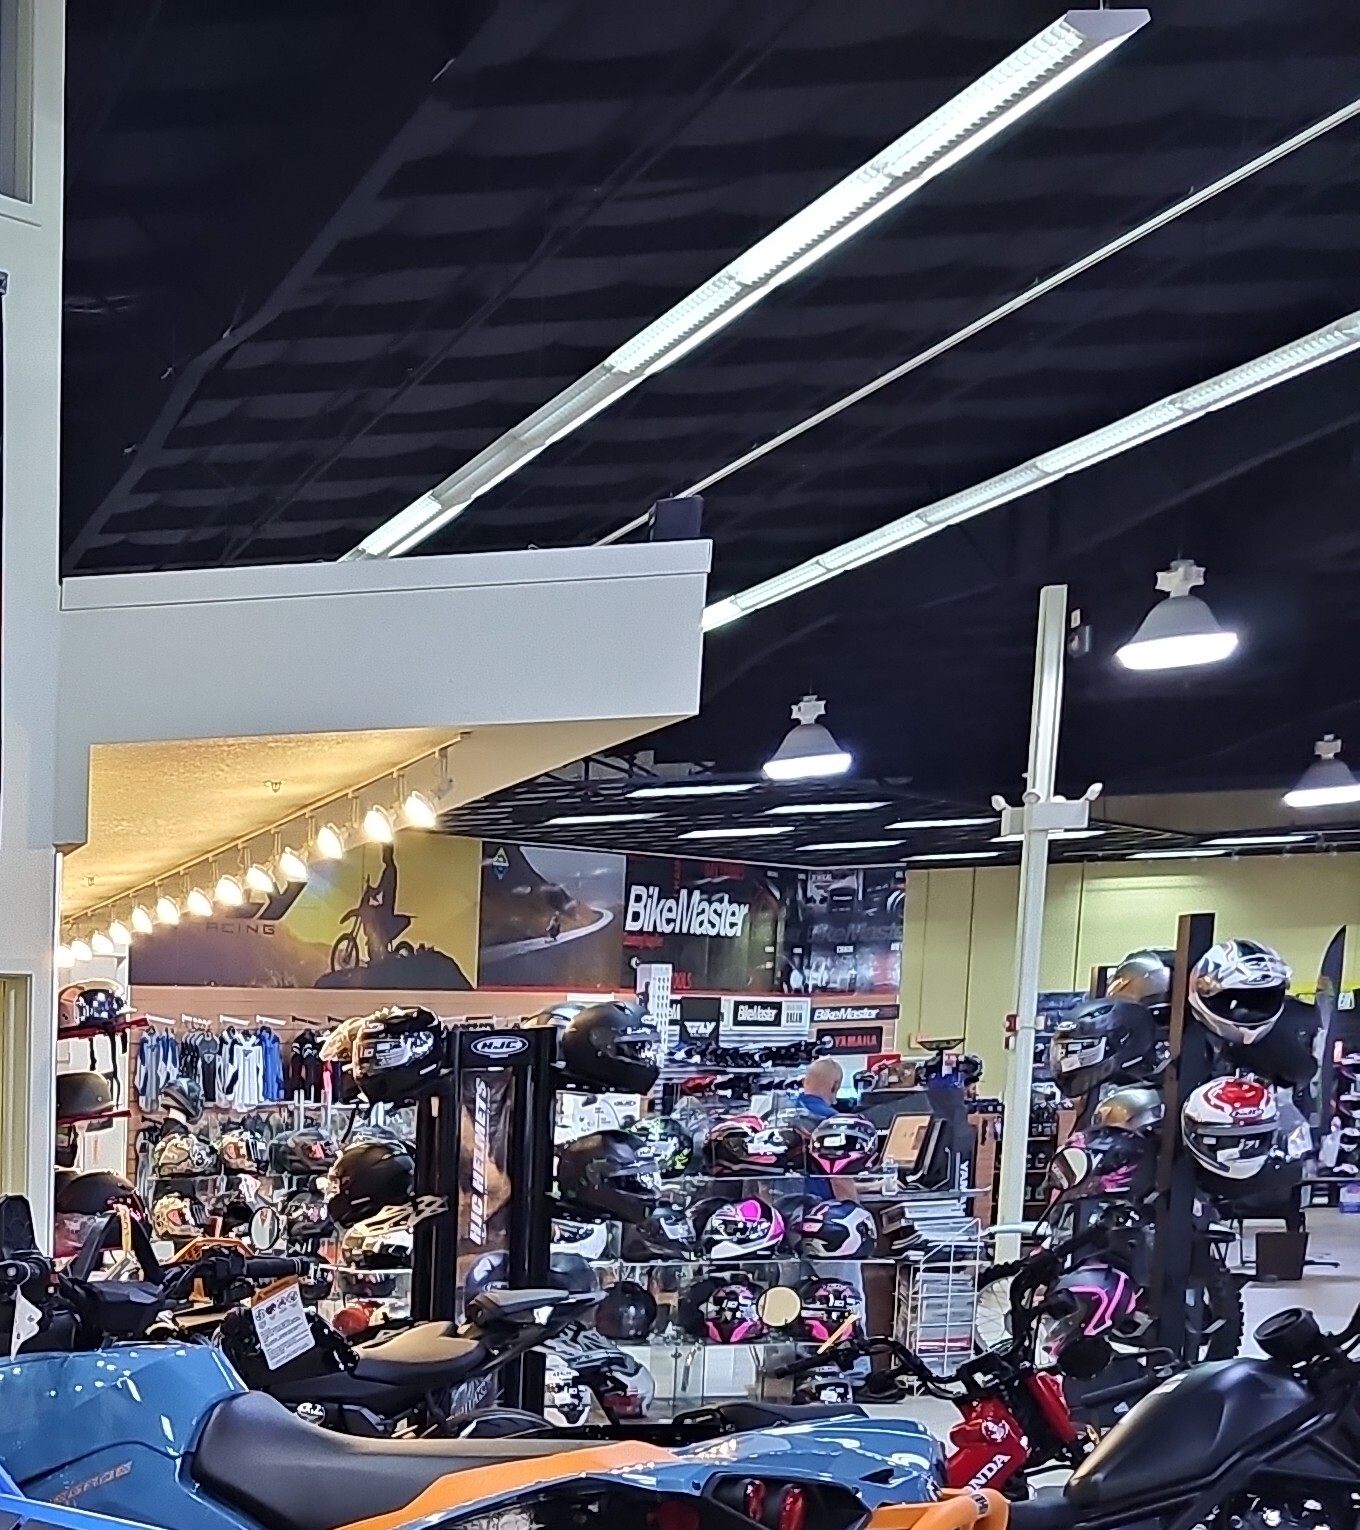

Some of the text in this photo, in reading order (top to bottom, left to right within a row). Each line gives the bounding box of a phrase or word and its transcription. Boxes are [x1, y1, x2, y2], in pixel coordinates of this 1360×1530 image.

[624, 884, 750, 937] BikeMaster
[206, 922, 276, 936] ACING
[737, 1004, 779, 1021] BikeMaster
[813, 1007, 880, 1021] BikeMaster
[481, 1040, 518, 1050] HJC
[834, 1034, 878, 1048] YAMAHA
[469, 1076, 488, 1246] HJC HELMETS
